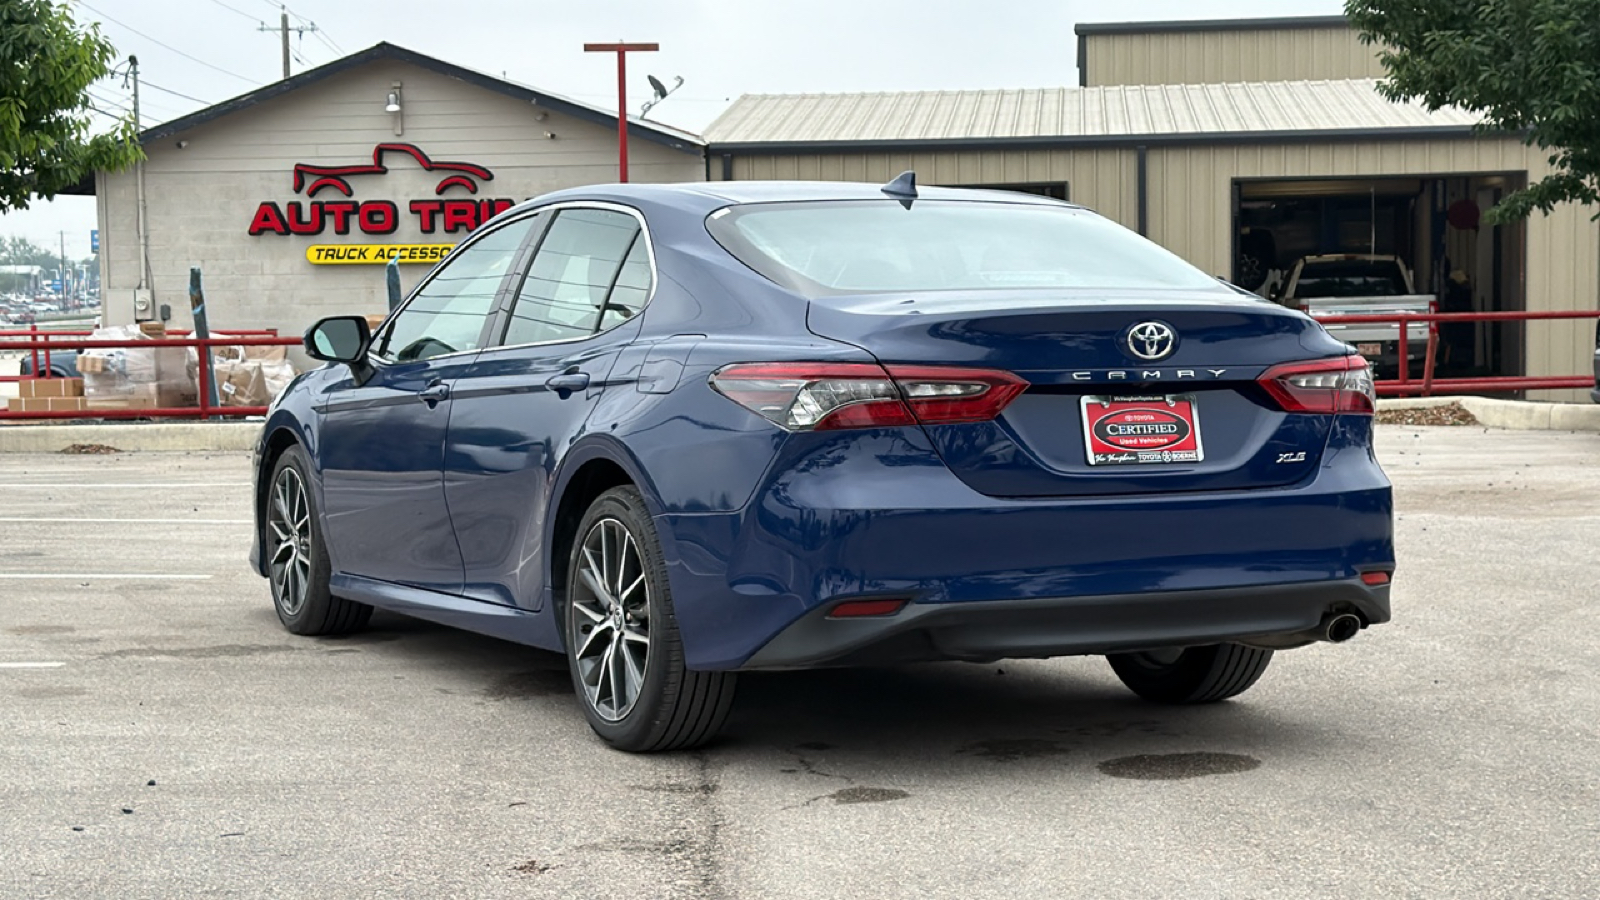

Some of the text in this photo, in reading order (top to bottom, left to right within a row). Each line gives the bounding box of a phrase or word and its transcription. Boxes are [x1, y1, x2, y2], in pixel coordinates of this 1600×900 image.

[249, 200, 399, 235] AUTO
[315, 246, 452, 260] TRUCK ACCESSO
[1072, 369, 1226, 380] CAMRY
[1275, 451, 1306, 463] XLE
